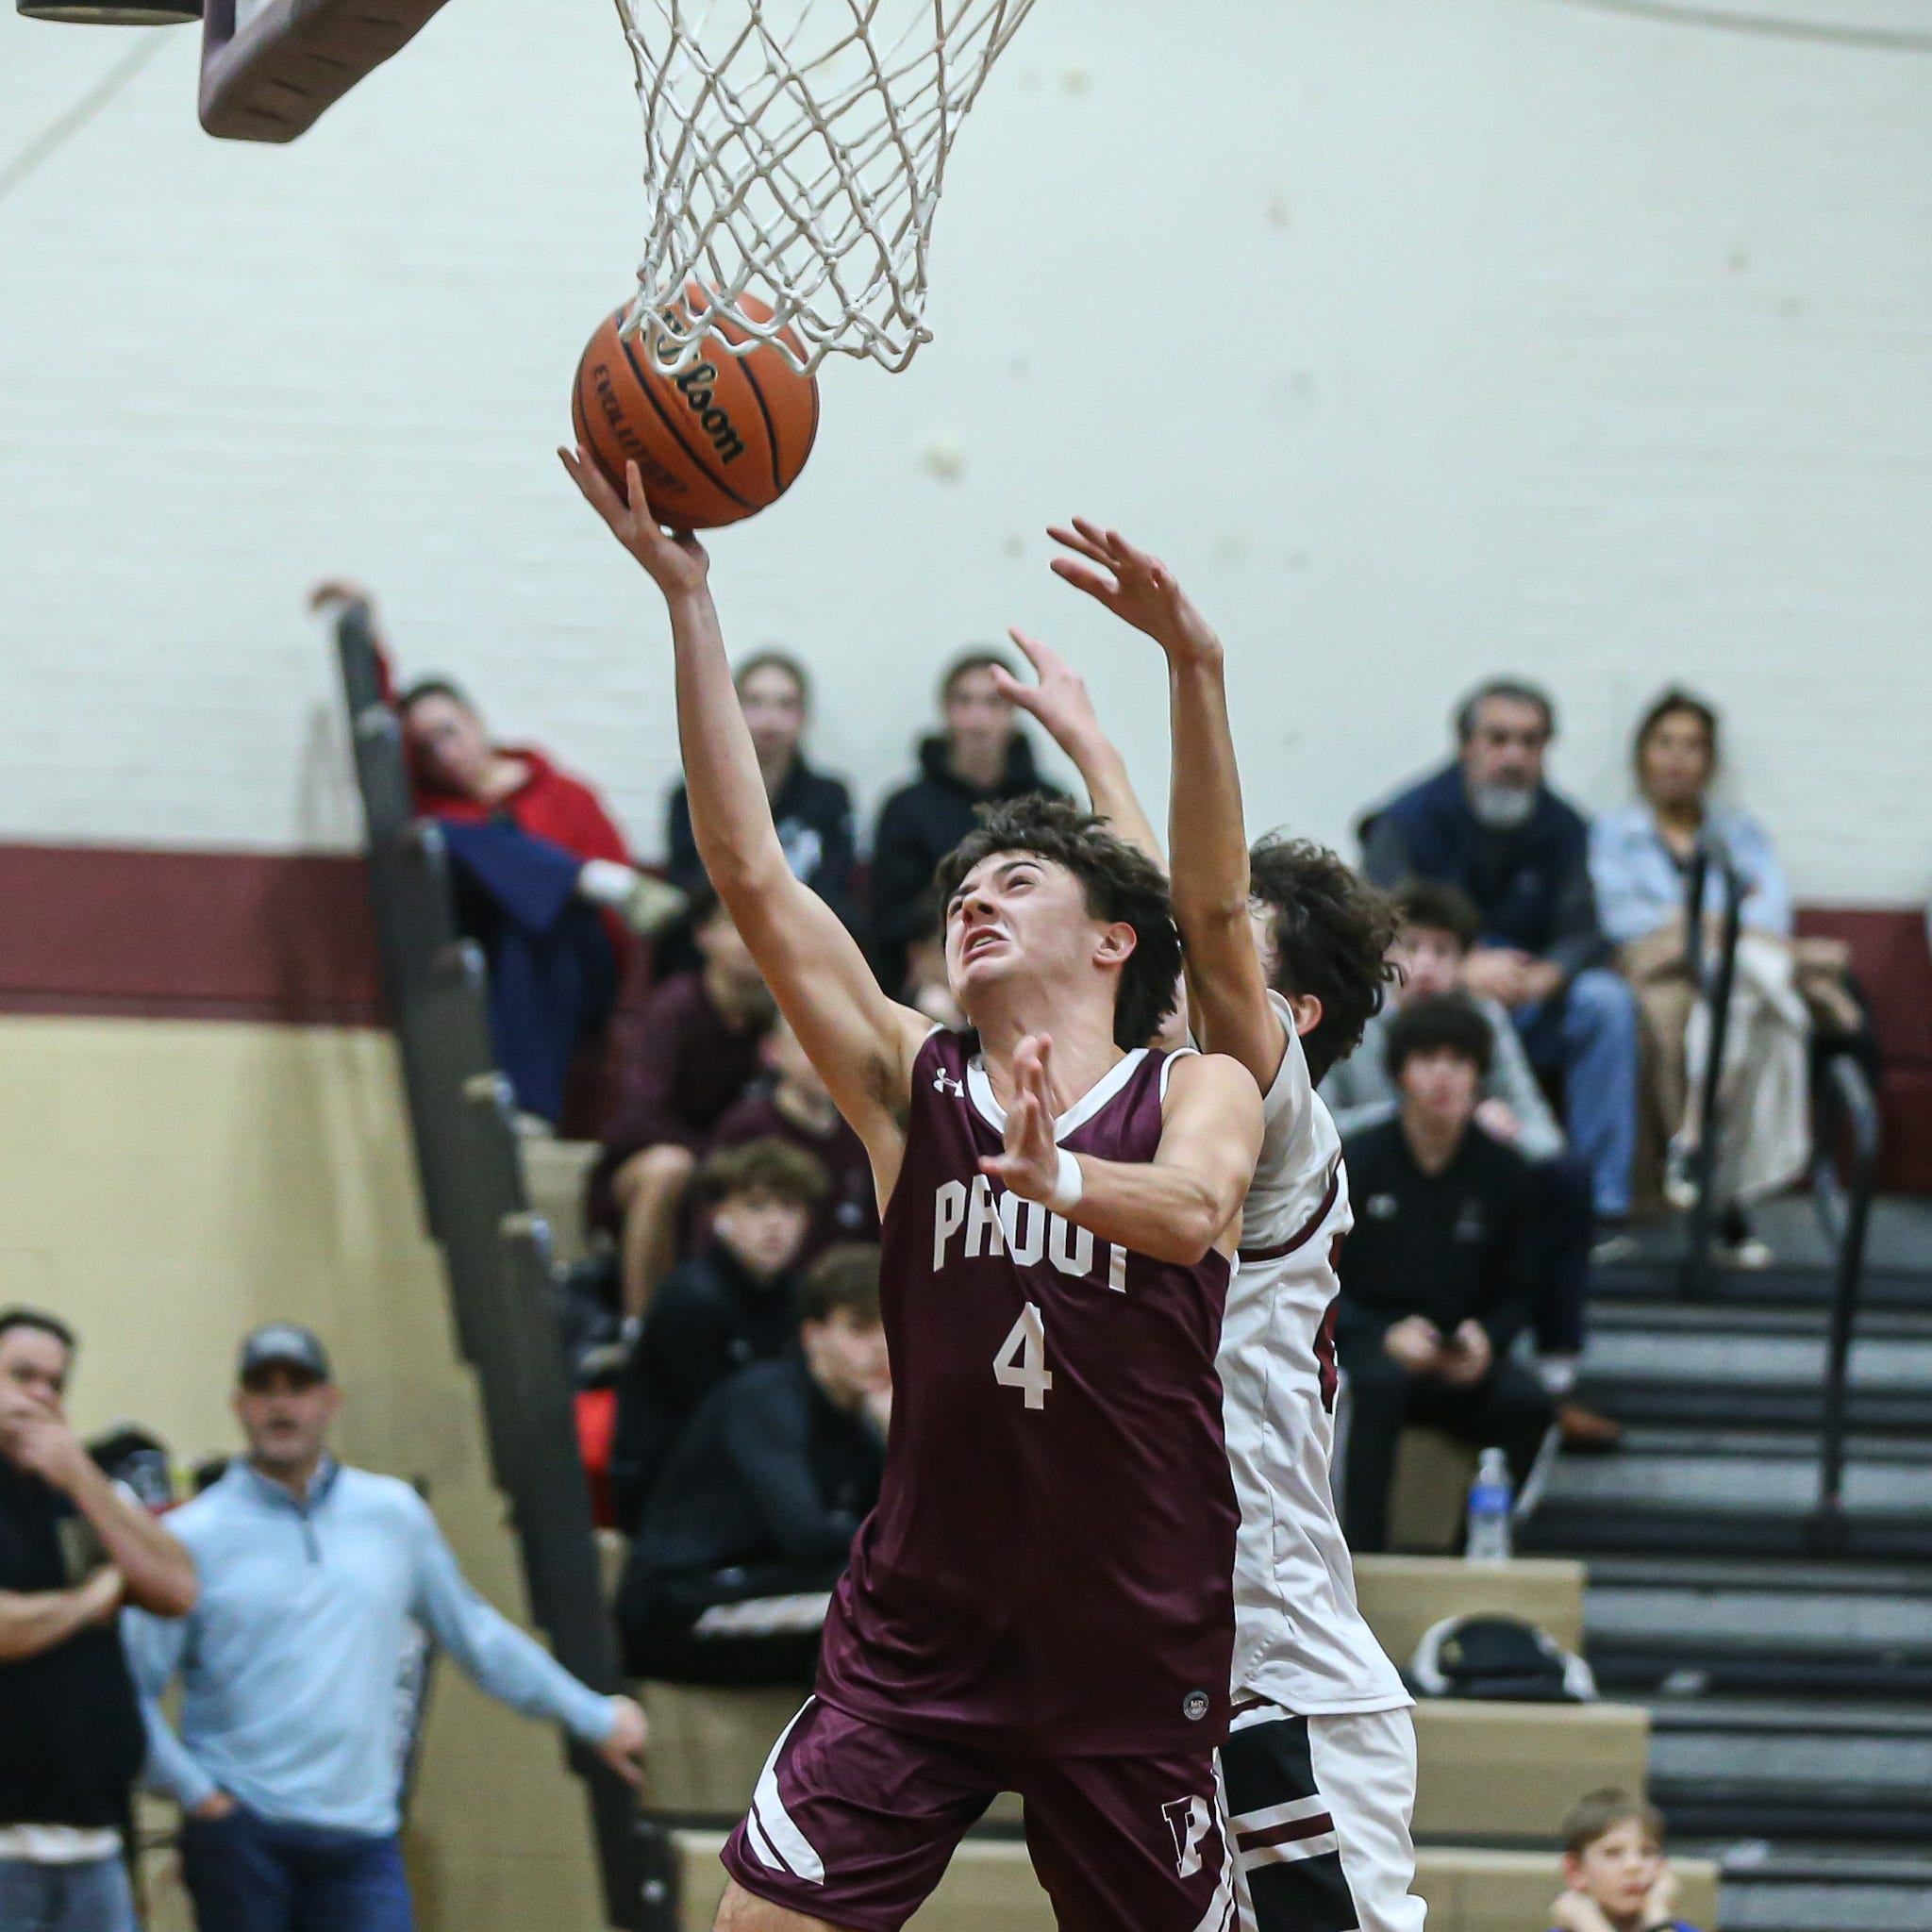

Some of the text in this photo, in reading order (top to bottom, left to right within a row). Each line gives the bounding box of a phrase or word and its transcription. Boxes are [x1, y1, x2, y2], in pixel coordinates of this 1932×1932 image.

[641, 308, 745, 464] lson
[992, 1301, 1053, 1409] 4
[1161, 1795, 1212, 1878] P
